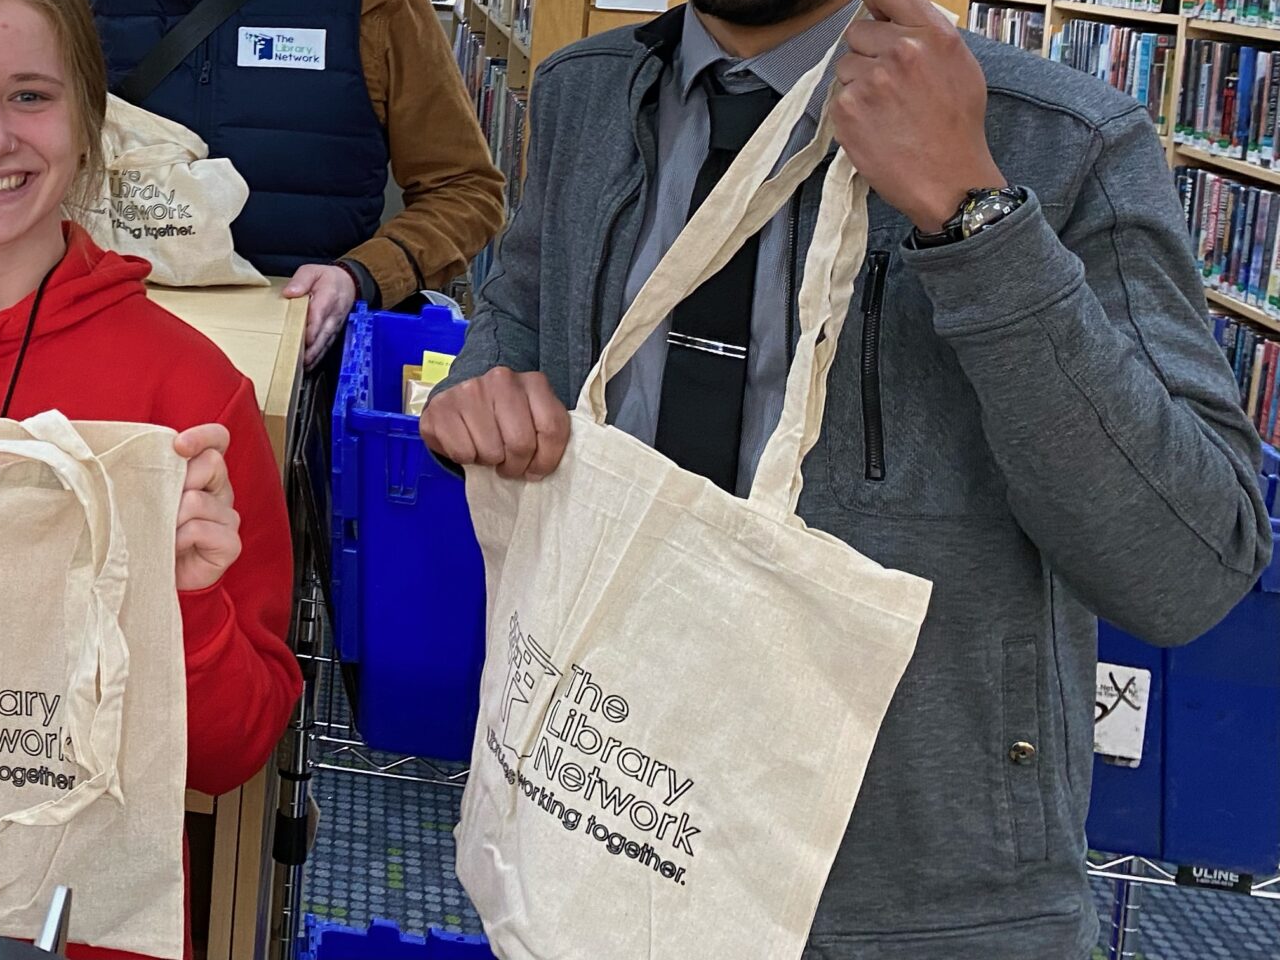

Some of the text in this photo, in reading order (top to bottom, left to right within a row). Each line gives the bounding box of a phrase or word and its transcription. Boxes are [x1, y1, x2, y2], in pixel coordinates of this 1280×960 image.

[275, 44, 312, 54] Library
[276, 35, 294, 44] The
[275, 53, 320, 64] Network
[108, 201, 193, 222] Nework
[564, 663, 630, 724] The
[545, 699, 695, 807] Library
[534, 736, 702, 857] Network
[585, 815, 686, 886] together.
[1192, 866, 1239, 883] ULINE
